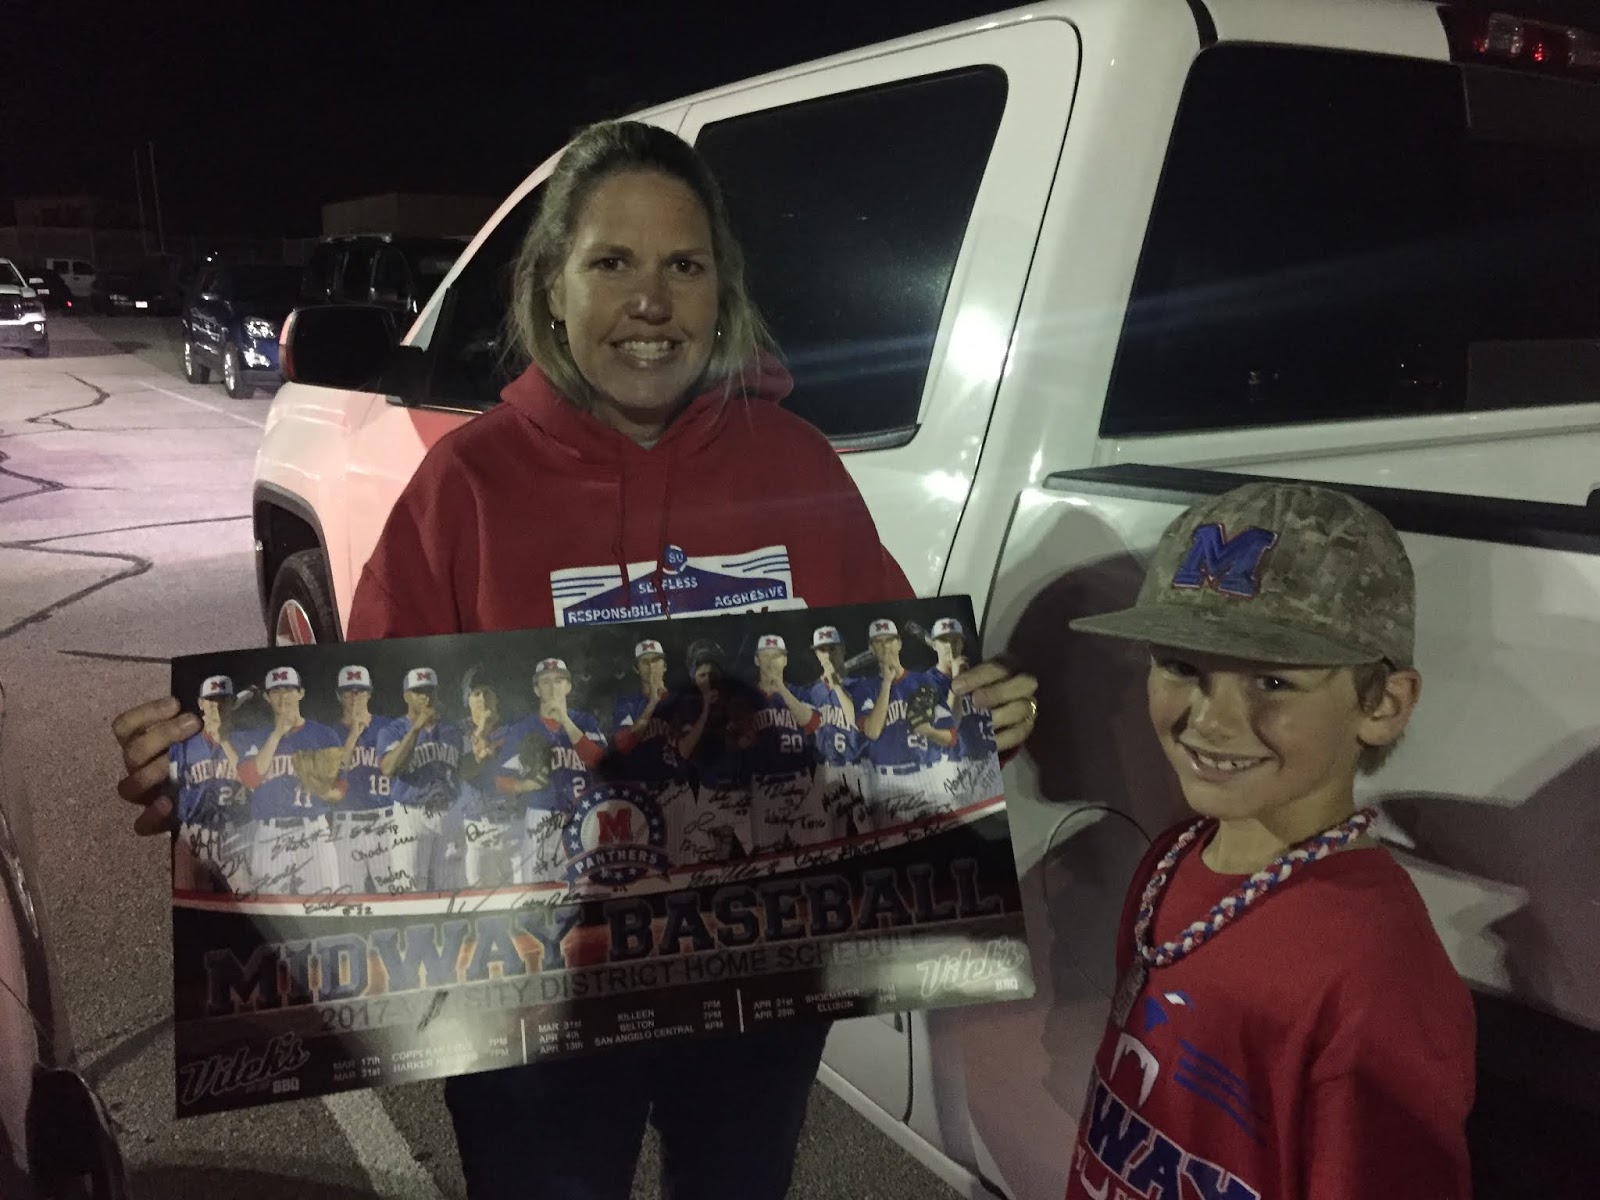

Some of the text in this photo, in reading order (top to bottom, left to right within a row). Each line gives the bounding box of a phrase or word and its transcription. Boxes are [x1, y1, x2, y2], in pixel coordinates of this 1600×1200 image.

[1172, 522, 1280, 600] M
[638, 576, 698, 595] SEFLESS
[567, 601, 670, 624] RESPONSIBILIT
[780, 734, 804, 754] 20
[833, 733, 846, 753] 6
[217, 785, 251, 807] 24
[369, 774, 392, 797] 18
[597, 807, 635, 846] M
[574, 848, 658, 876] PANTHERS
[203, 856, 1002, 1018] MIDWAY BASEBALL
[320, 1000, 388, 1032] 2017
[541, 959, 684, 999] DISTRICT
[684, 949, 767, 981] HOME
[538, 1023, 559, 1034] MAR
[617, 1008, 655, 1022] KILLEEN
[702, 1001, 721, 1010] 7PM
[566, 1030, 580, 1041] 4th
[619, 1019, 655, 1032] BELTON
[703, 1010, 722, 1020] 7PM
[594, 1035, 613, 1047] SAN
[614, 1030, 653, 1044] ANGELO
[654, 1024, 696, 1039] CENTRAL
[271, 1078, 300, 1095] BBQ
